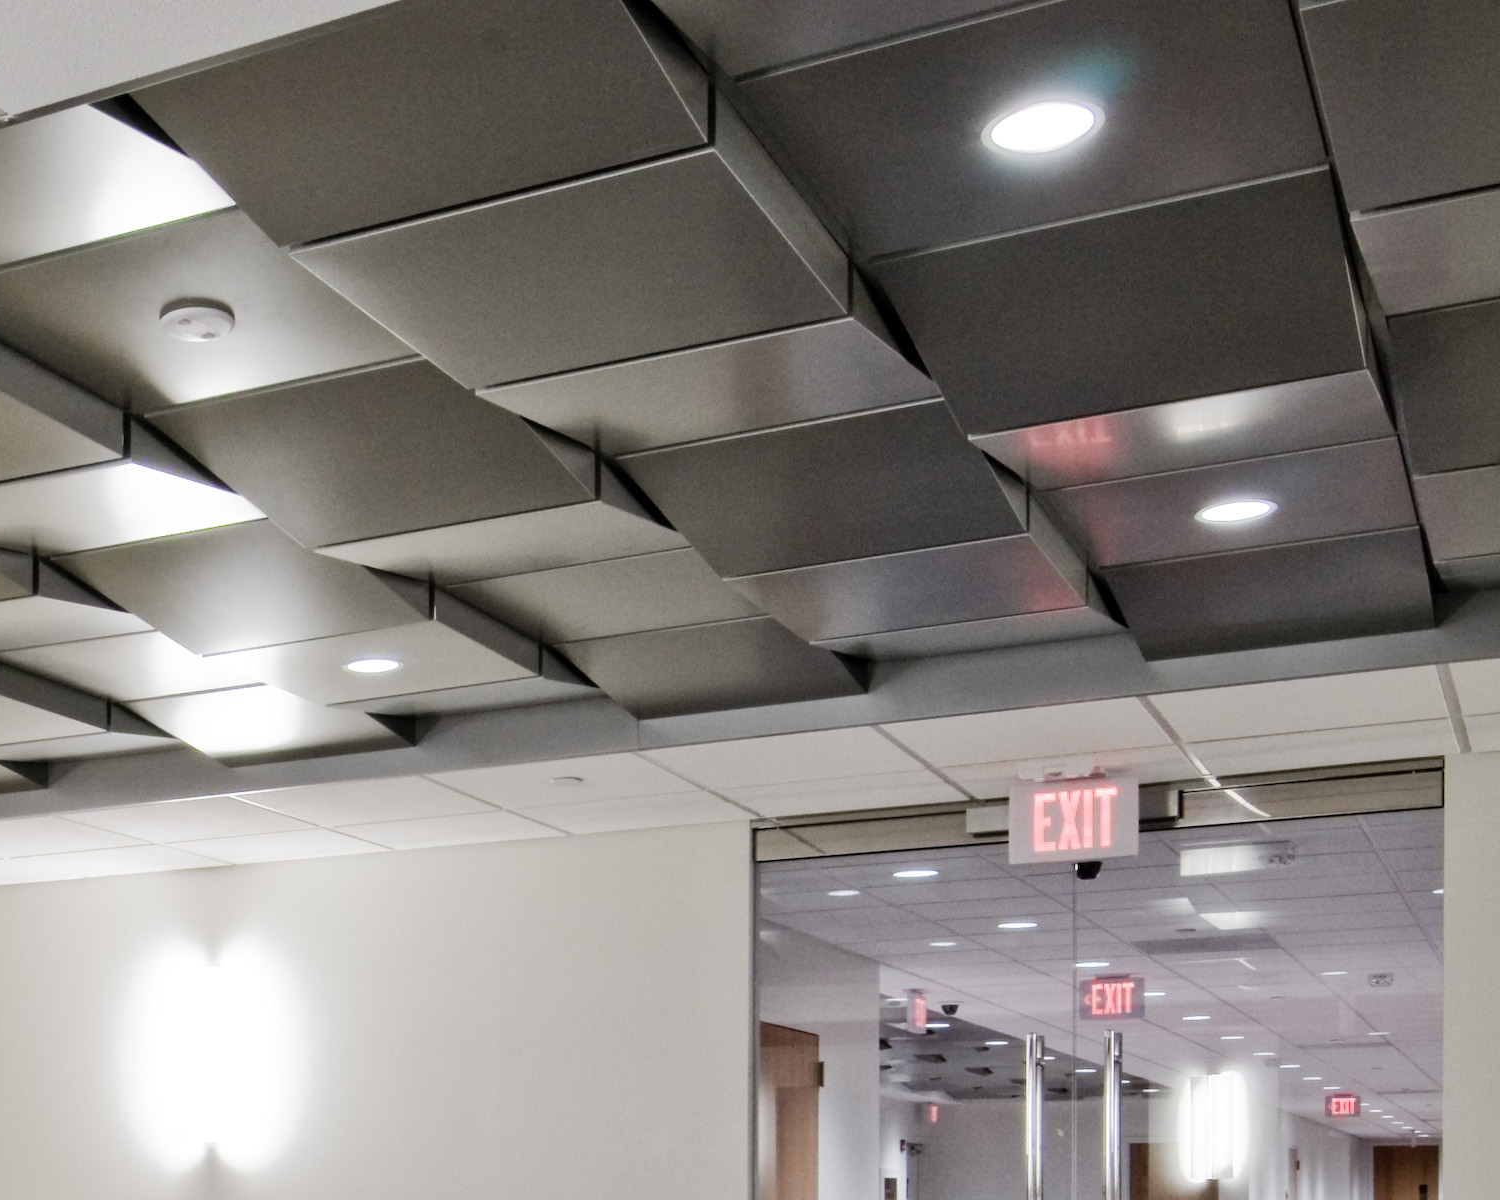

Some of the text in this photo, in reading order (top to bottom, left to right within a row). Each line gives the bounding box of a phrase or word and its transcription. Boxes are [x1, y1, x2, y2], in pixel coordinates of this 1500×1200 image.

[1033, 787, 1118, 851] EXIT
[1091, 982, 1135, 1015] EXIT
[1331, 1097, 1356, 1115] EXIT
